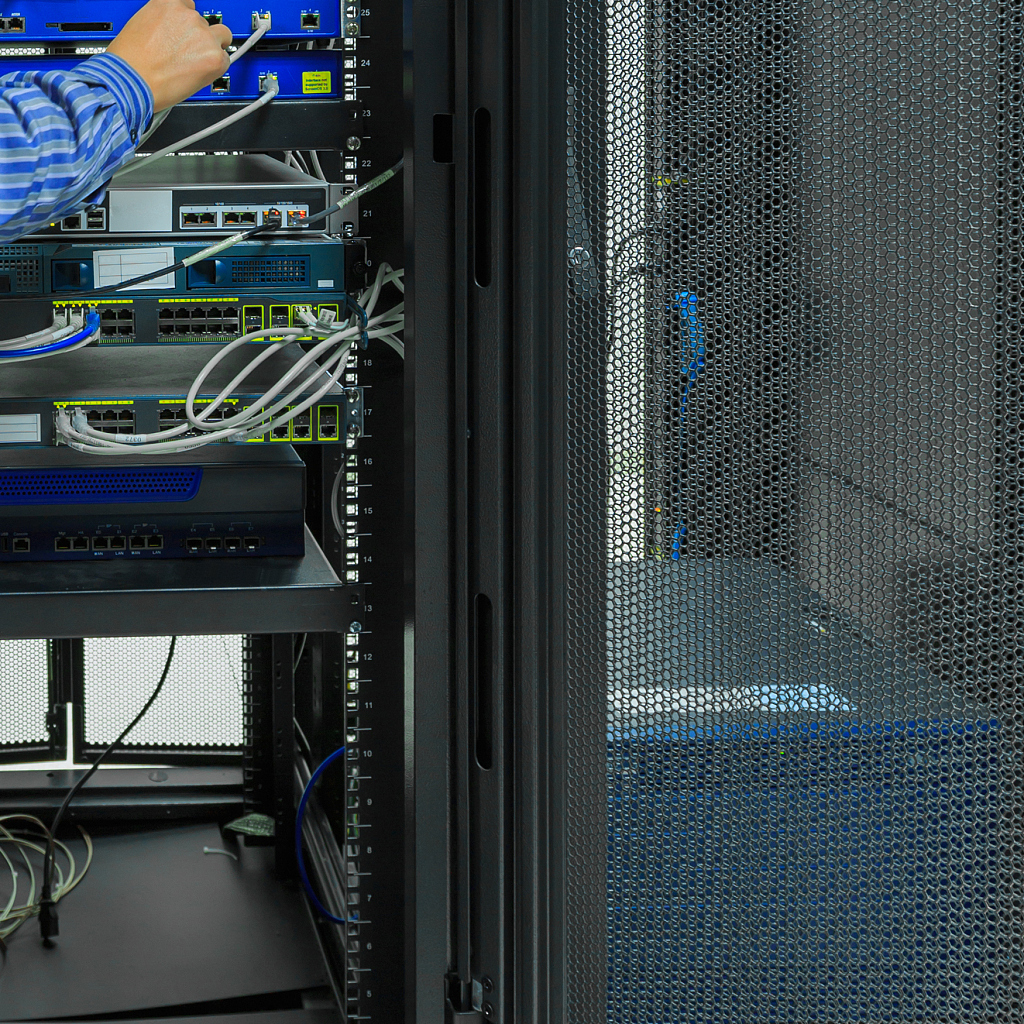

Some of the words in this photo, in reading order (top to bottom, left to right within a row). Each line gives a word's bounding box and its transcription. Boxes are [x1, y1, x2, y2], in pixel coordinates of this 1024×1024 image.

[361, 8, 371, 17] 25
[360, 59, 371, 67] 24
[362, 109, 372, 117] 23
[361, 159, 372, 167] 22
[362, 209, 372, 218] 21
[363, 359, 373, 367] 18
[364, 409, 373, 417] 17
[363, 457, 373, 465] 16
[363, 507, 373, 515] 15
[363, 555, 373, 563] 14
[363, 653, 373, 661] 12
[364, 701, 373, 709] 11
[363, 749, 373, 758] 10
